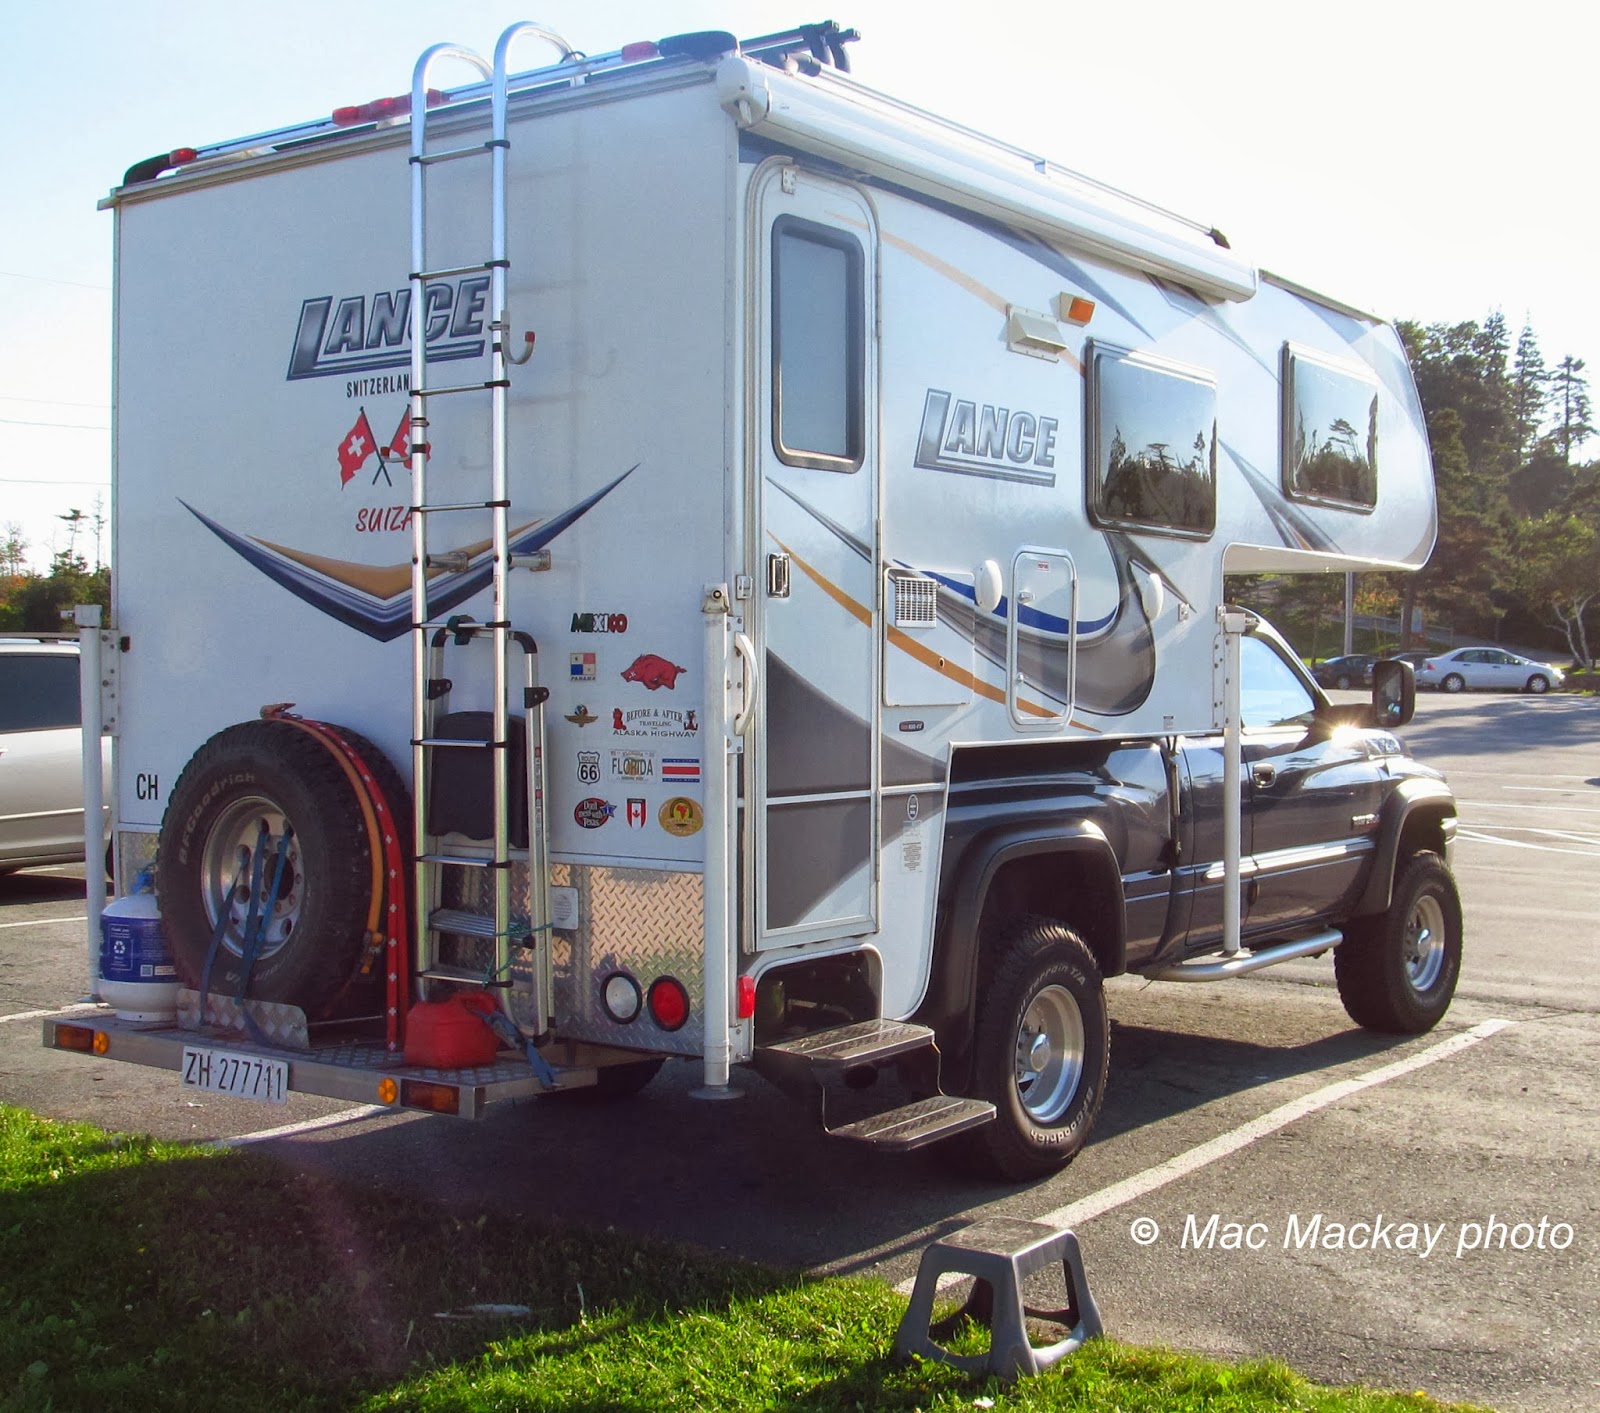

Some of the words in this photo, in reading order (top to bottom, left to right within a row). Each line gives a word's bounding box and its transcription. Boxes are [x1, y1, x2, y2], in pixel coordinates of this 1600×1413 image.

[286, 276, 491, 381] LANCE
[346, 373, 412, 399] SWITZERLAN
[913, 388, 1059, 488] LANCE
[570, 613, 628, 634] MEXICO
[626, 709, 651, 722] BEFORE
[662, 709, 683, 724] AFTER
[650, 730, 697, 738] HIGHWAY
[580, 764, 598, 781] 66
[611, 757, 654, 776] FLORIDA
[136, 773, 158, 800] CH
[184, 1051, 212, 1088] ZH
[218, 1057, 283, 1100] 277711
